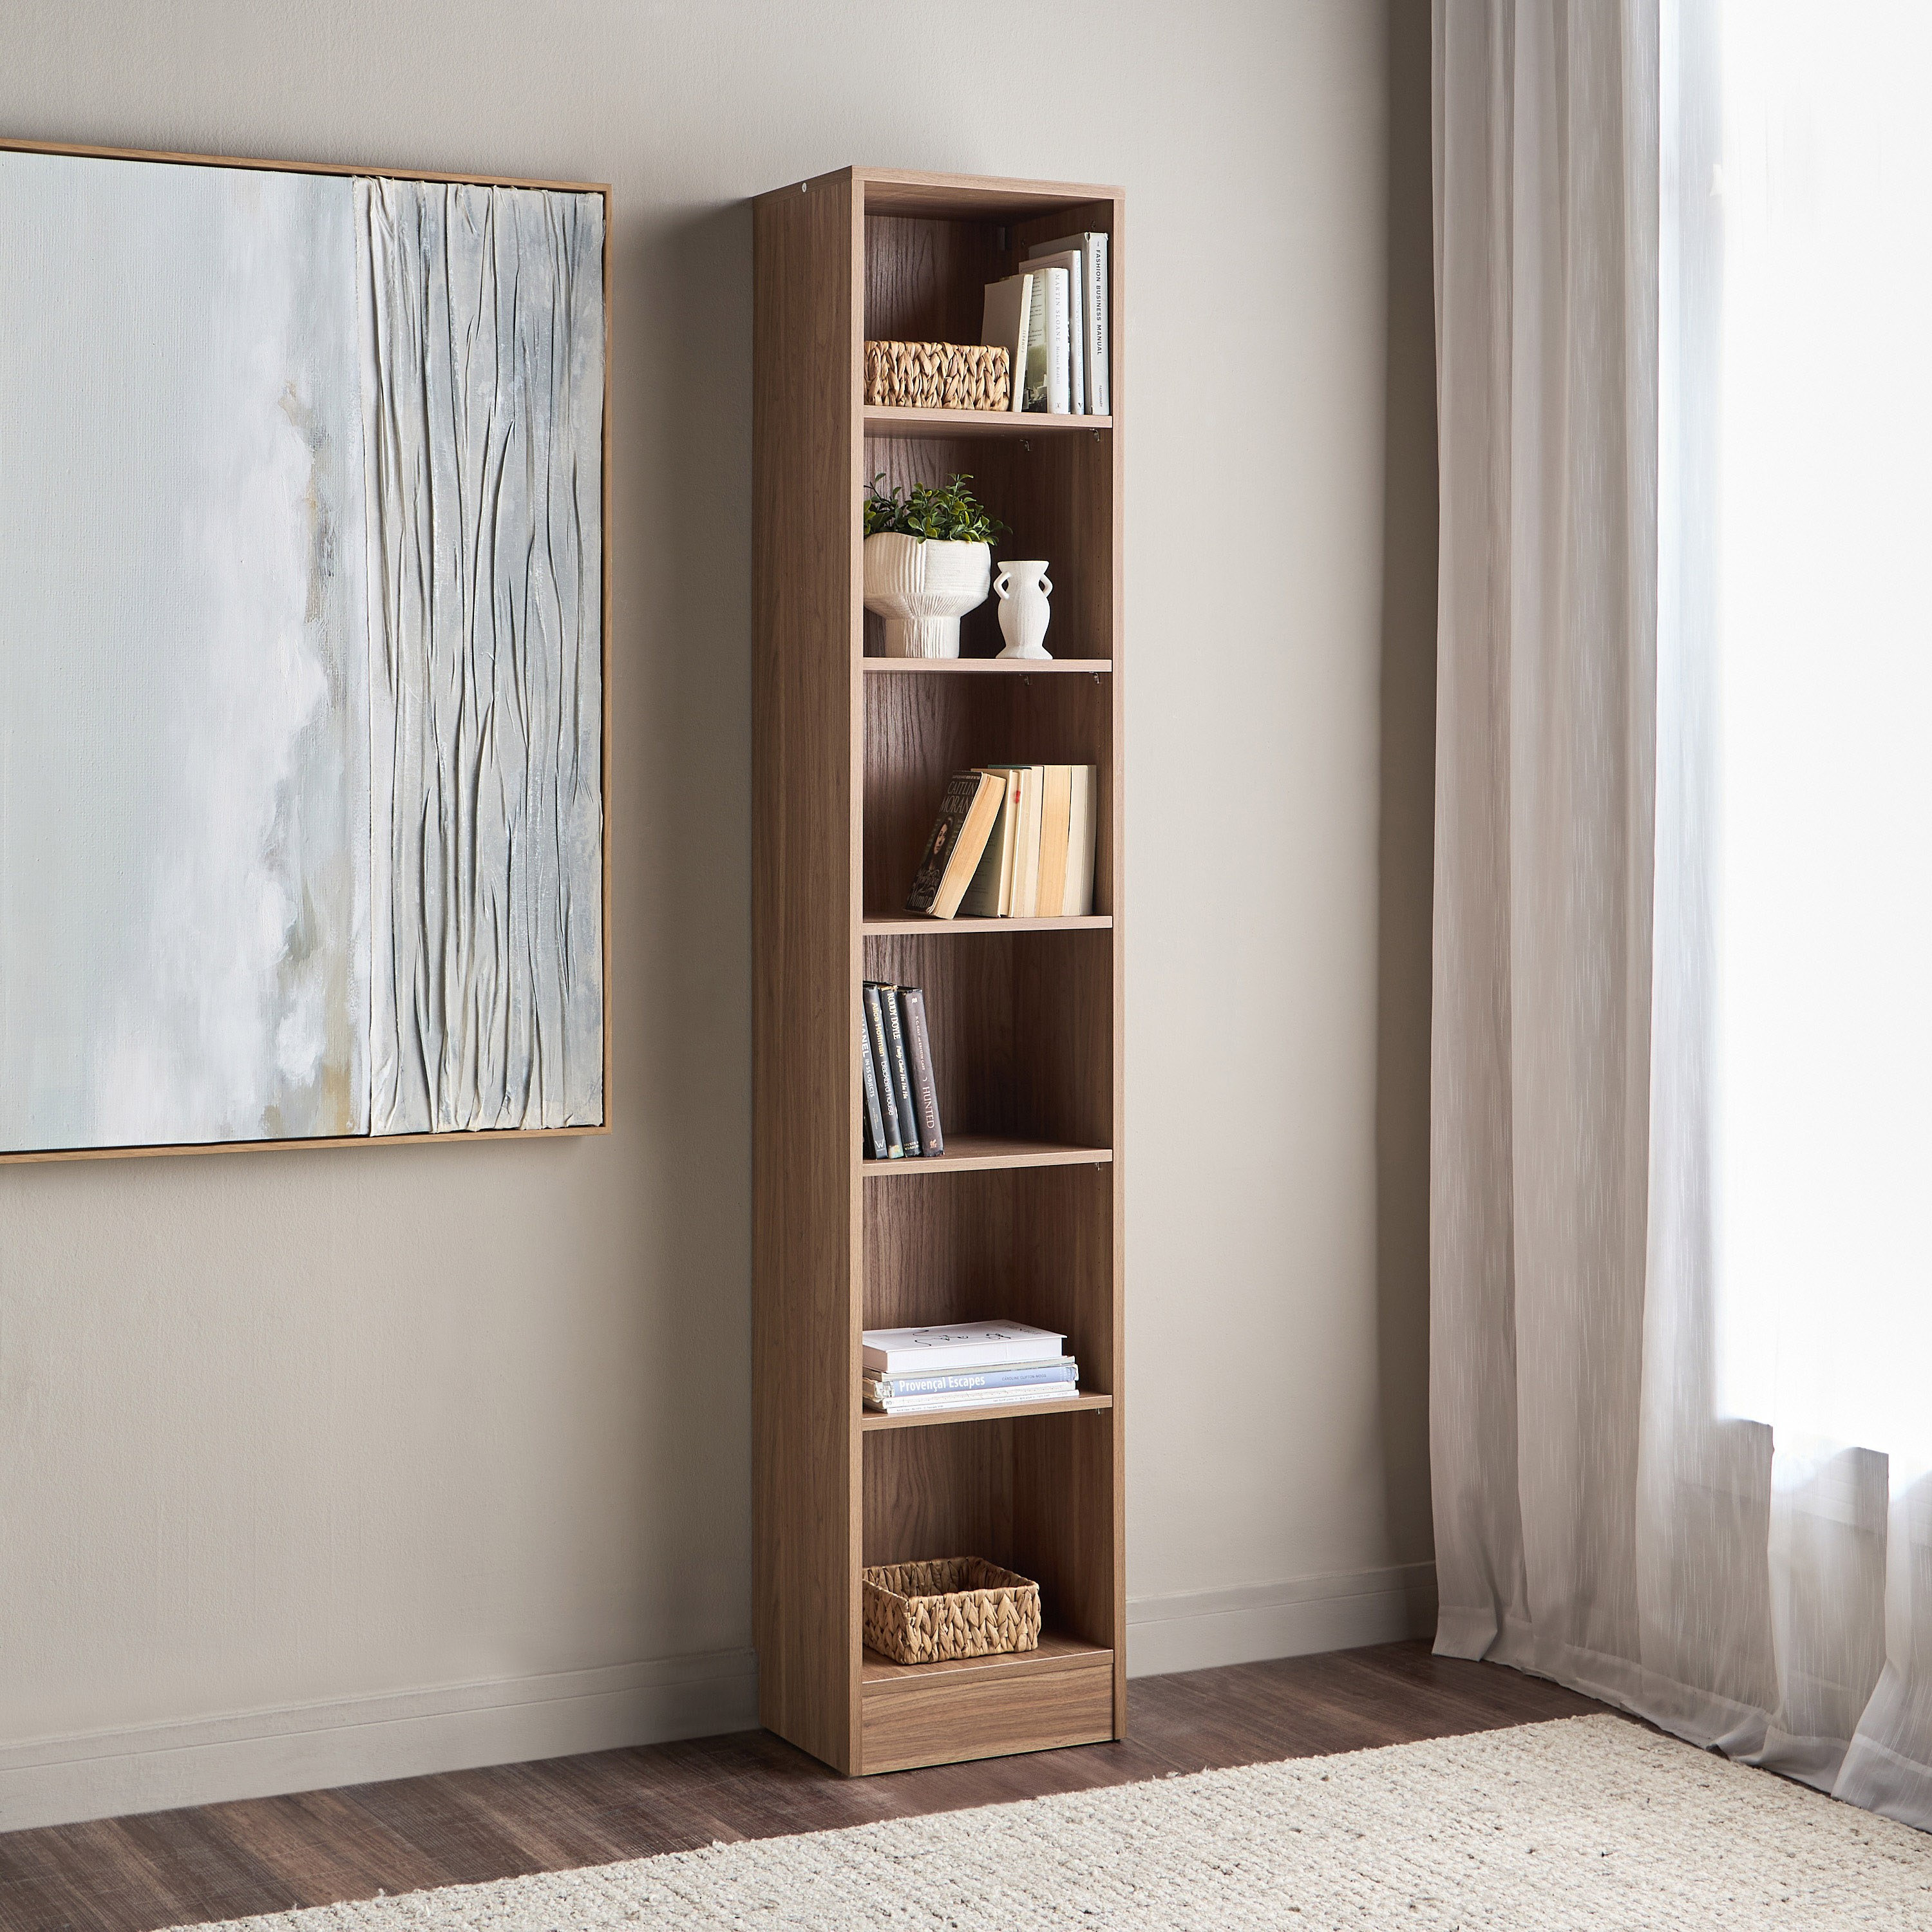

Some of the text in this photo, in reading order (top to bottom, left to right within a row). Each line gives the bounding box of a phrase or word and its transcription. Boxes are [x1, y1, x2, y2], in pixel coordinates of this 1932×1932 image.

[947, 781, 978, 795] CAITLIN
[939, 795, 972, 813] MORAN
[887, 992, 901, 1040] RODDY DOYLE
[875, 1023, 886, 1057] Hoffman
[867, 1074, 875, 1097] OBJECTS
[900, 1074, 907, 1082] Ha
[901, 1082, 907, 1090] Ha
[880, 1061, 895, 1116] blackbird house
[902, 1090, 909, 1099] Ha
[922, 1086, 935, 1128] HUNTED
[898, 1376, 985, 1392] Provençal Escapes
